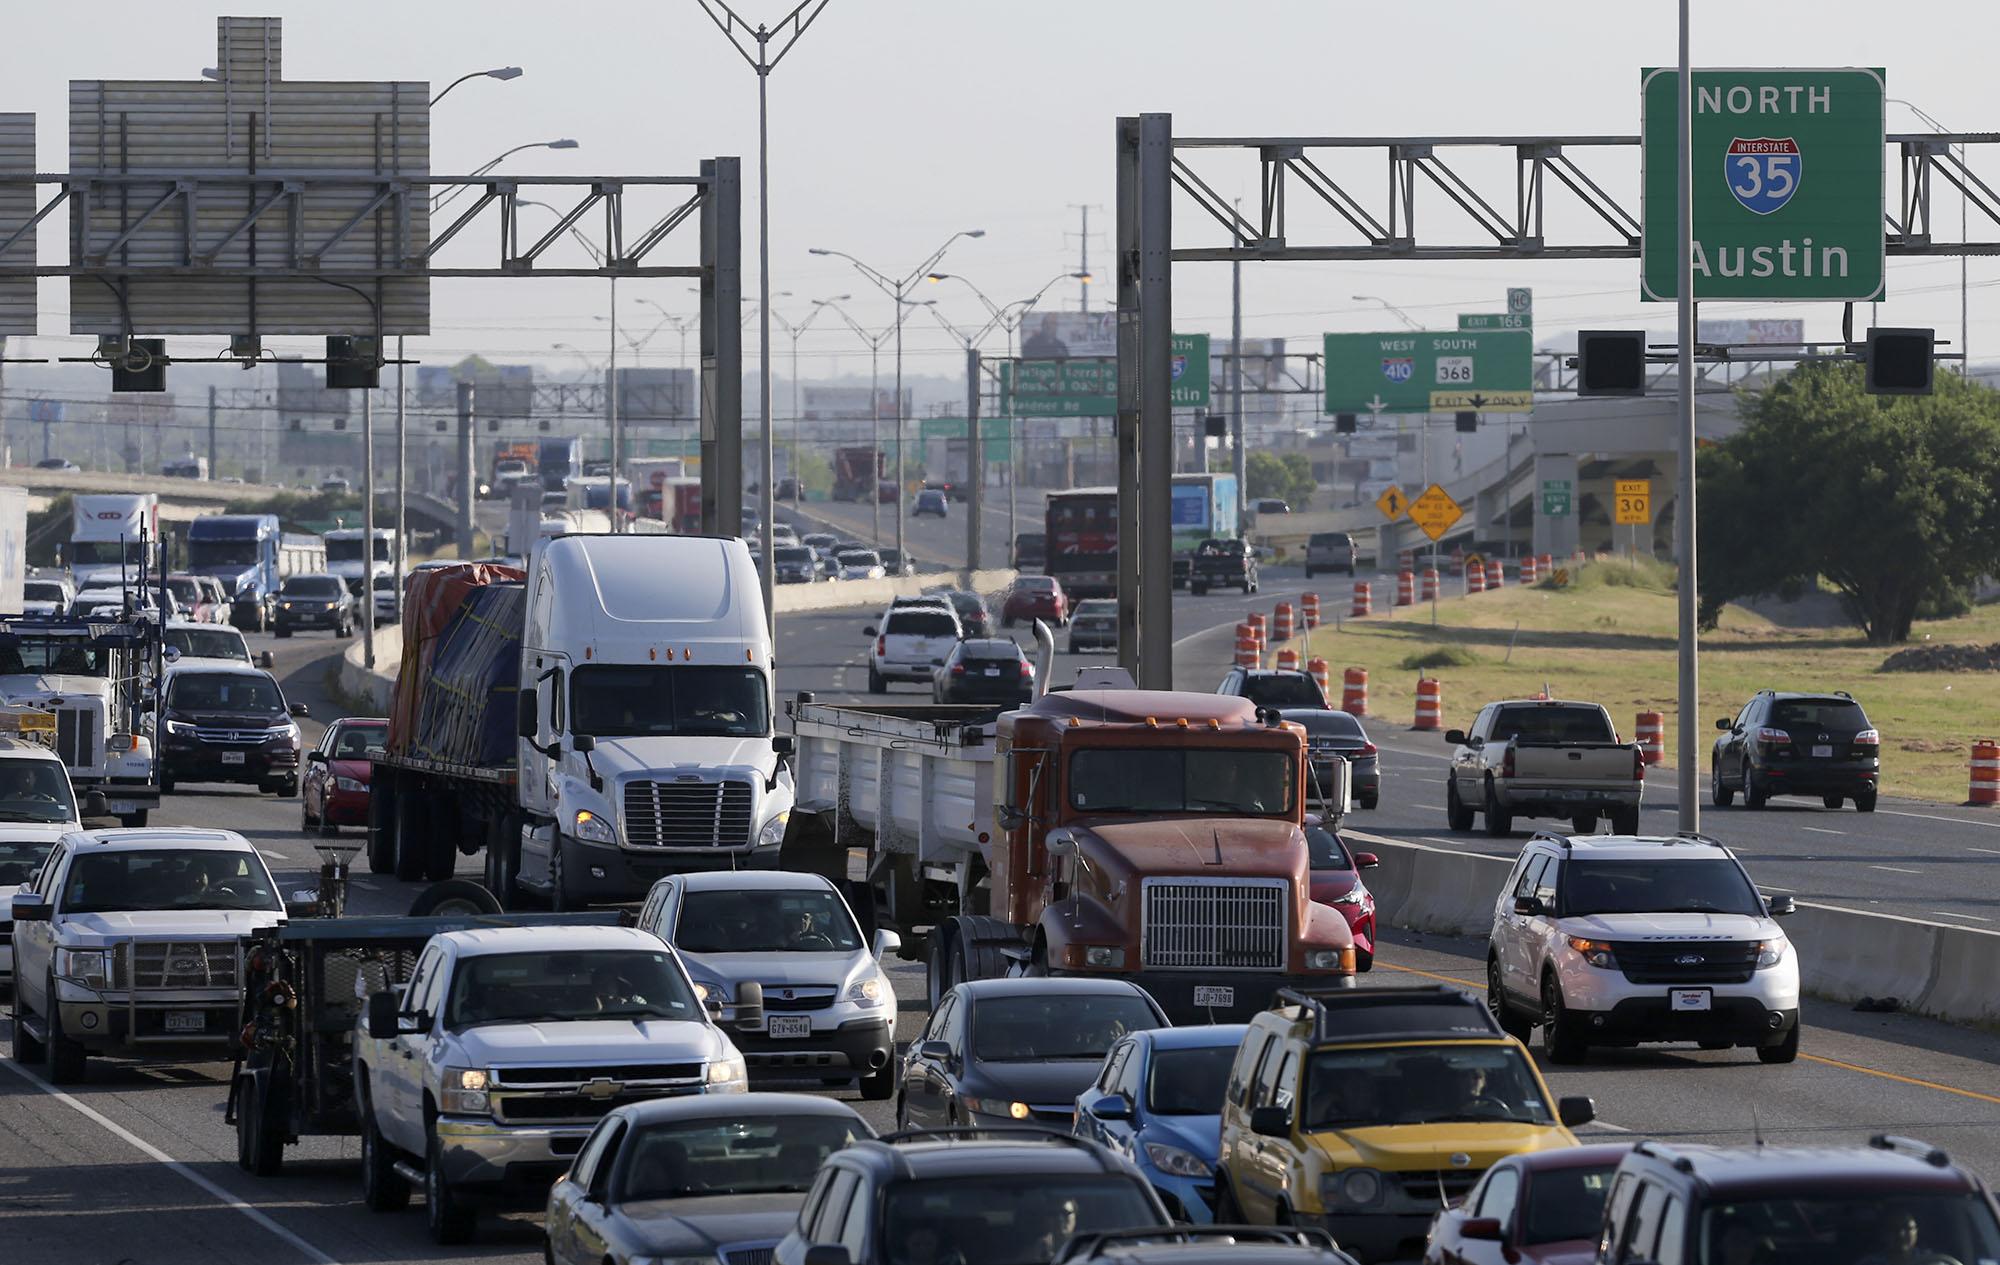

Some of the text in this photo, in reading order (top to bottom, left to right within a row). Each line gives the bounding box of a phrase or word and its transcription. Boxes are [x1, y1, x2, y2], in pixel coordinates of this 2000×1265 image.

[1697, 86, 1831, 114] NORTH
[1737, 142, 1790, 153] INTERSTATE
[1735, 156, 1793, 198] 35
[1692, 238, 1848, 277] Austin
[1467, 316, 1522, 327] EXIT 166
[1171, 341, 1193, 350] RTH
[1380, 340, 1477, 350] WEST SOUTH
[1386, 363, 1411, 378] 410
[1440, 366, 1471, 380] 368
[1171, 386, 1200, 401] stin
[1435, 396, 1528, 408] EXIT ONLY
[1621, 499, 1645, 512] 30
